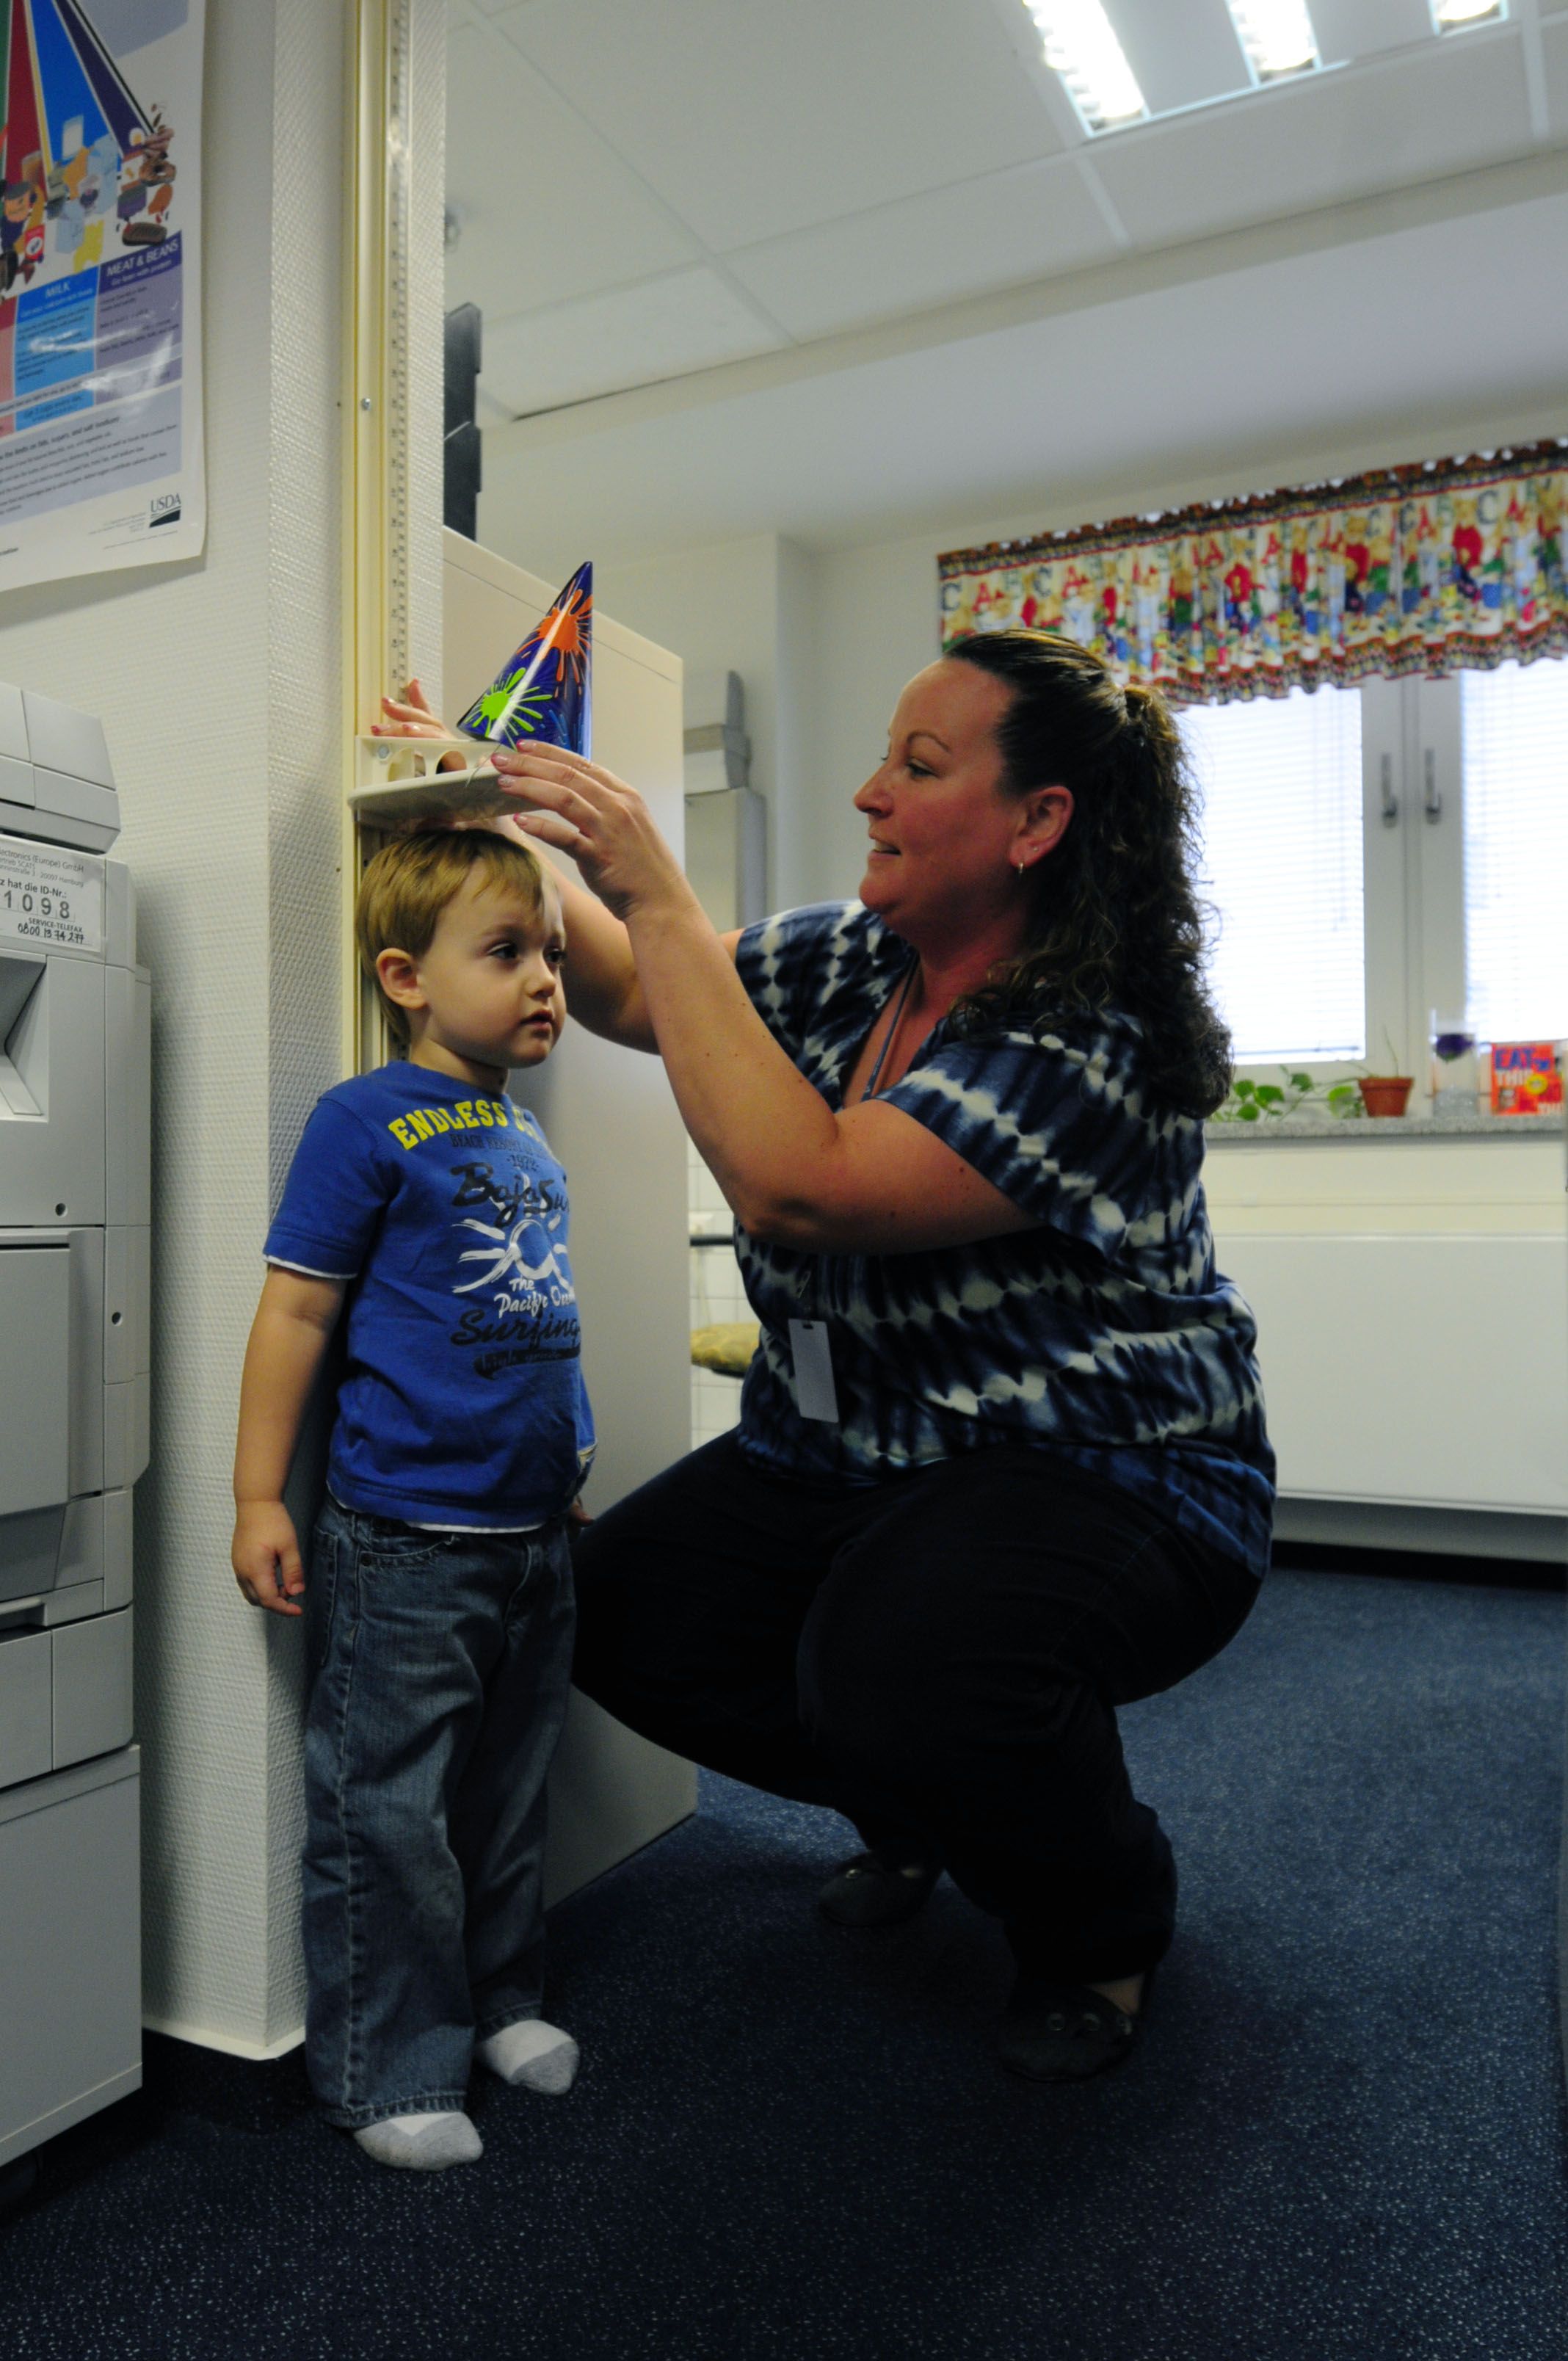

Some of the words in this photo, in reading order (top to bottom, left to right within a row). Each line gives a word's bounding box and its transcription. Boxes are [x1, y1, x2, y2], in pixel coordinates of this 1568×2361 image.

[106, 255, 136, 276] MEAT
[137, 255, 145, 267] &
[146, 239, 179, 263] BEANS
[45, 281, 70, 299] MILK
[150, 493, 181, 513] USDA
[32, 855, 61, 868] (Europe)
[62, 861, 84, 874] GmbH
[7, 877, 22, 890] hat
[24, 882, 38, 893] die
[40, 885, 67, 899] ID-Nr.:
[18, 921, 40, 937] 0800
[28, 917, 83, 933] SERVICE-TELEFAX
[1495, 1048, 1536, 1070] EAT
[388, 1099, 508, 1150] ENDLESS
[449, 1133, 485, 1148] BEACH
[509, 1277, 535, 1292] The
[493, 1291, 548, 1319] Pacific
[451, 1305, 581, 1351] Surfing
